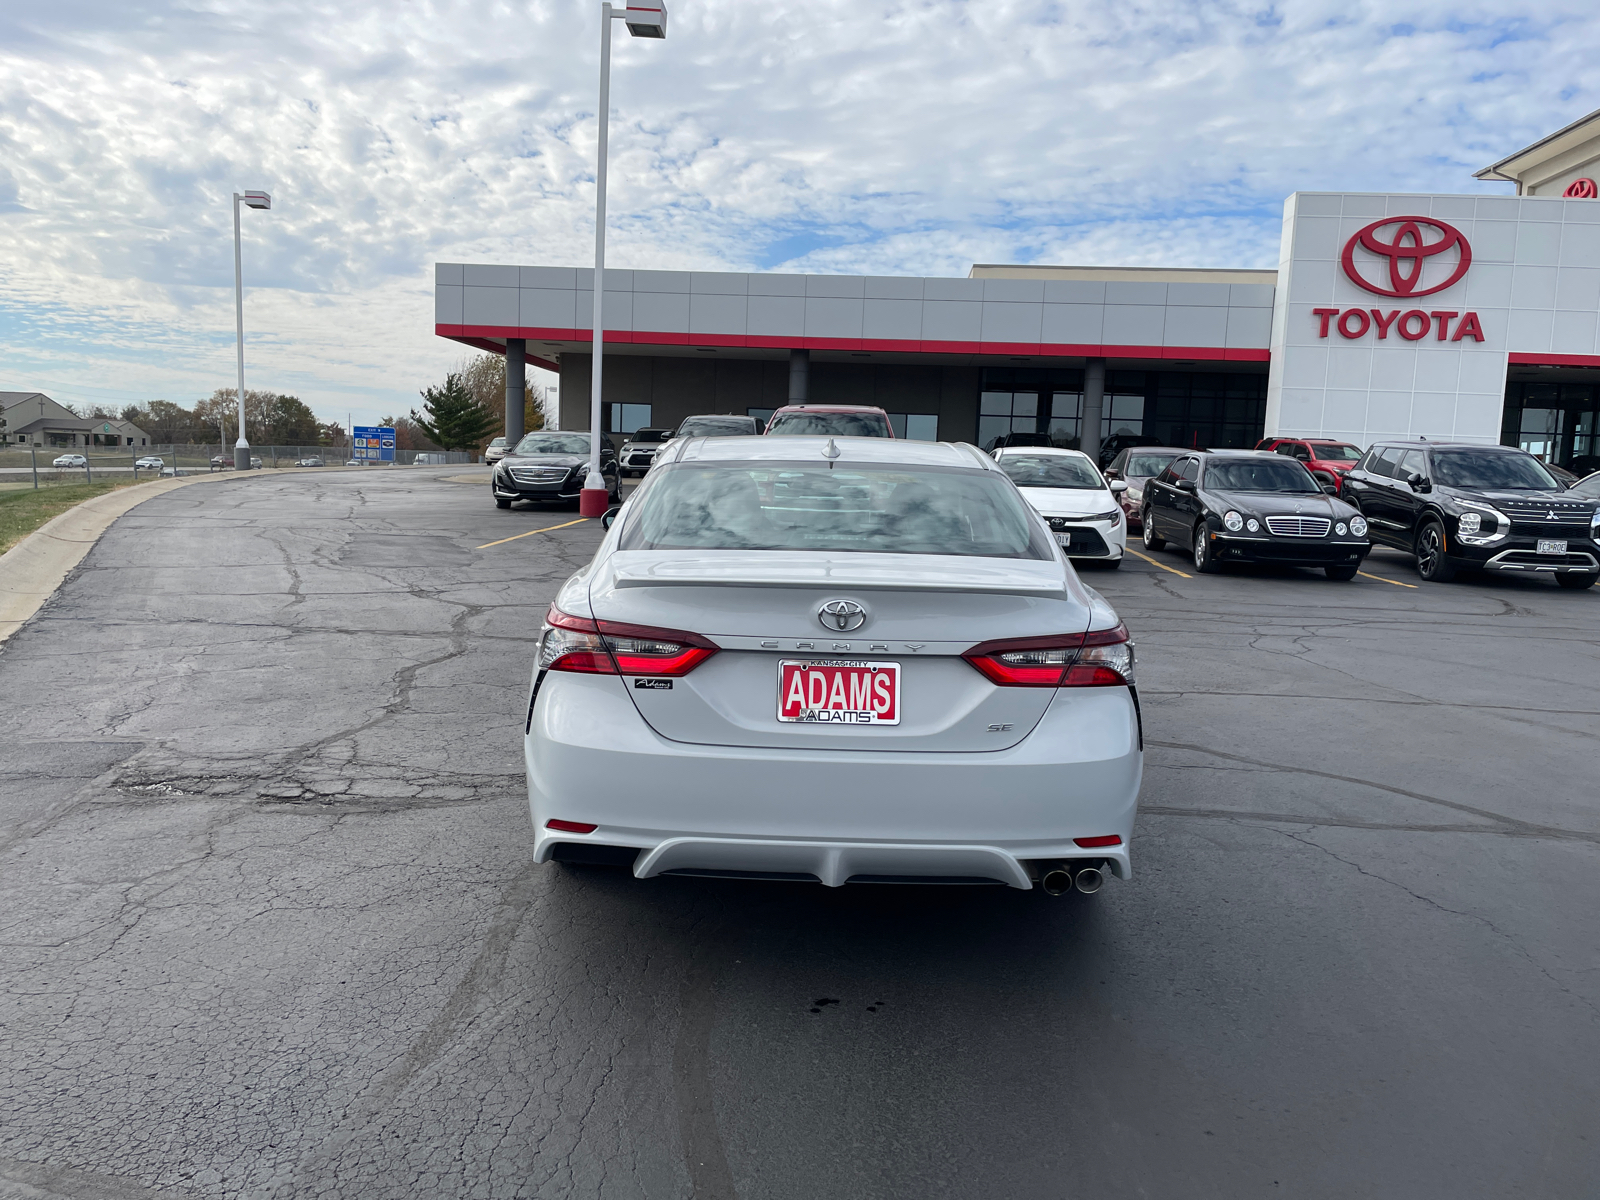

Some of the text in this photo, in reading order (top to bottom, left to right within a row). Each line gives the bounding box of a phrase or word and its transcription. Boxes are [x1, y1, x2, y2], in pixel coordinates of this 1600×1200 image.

[1313, 308, 1485, 342] TOYOTA
[760, 640, 926, 652] CAMRY
[785, 670, 891, 714] ADAMS
[805, 710, 871, 722] ADAMS
[986, 722, 1014, 732] SE
